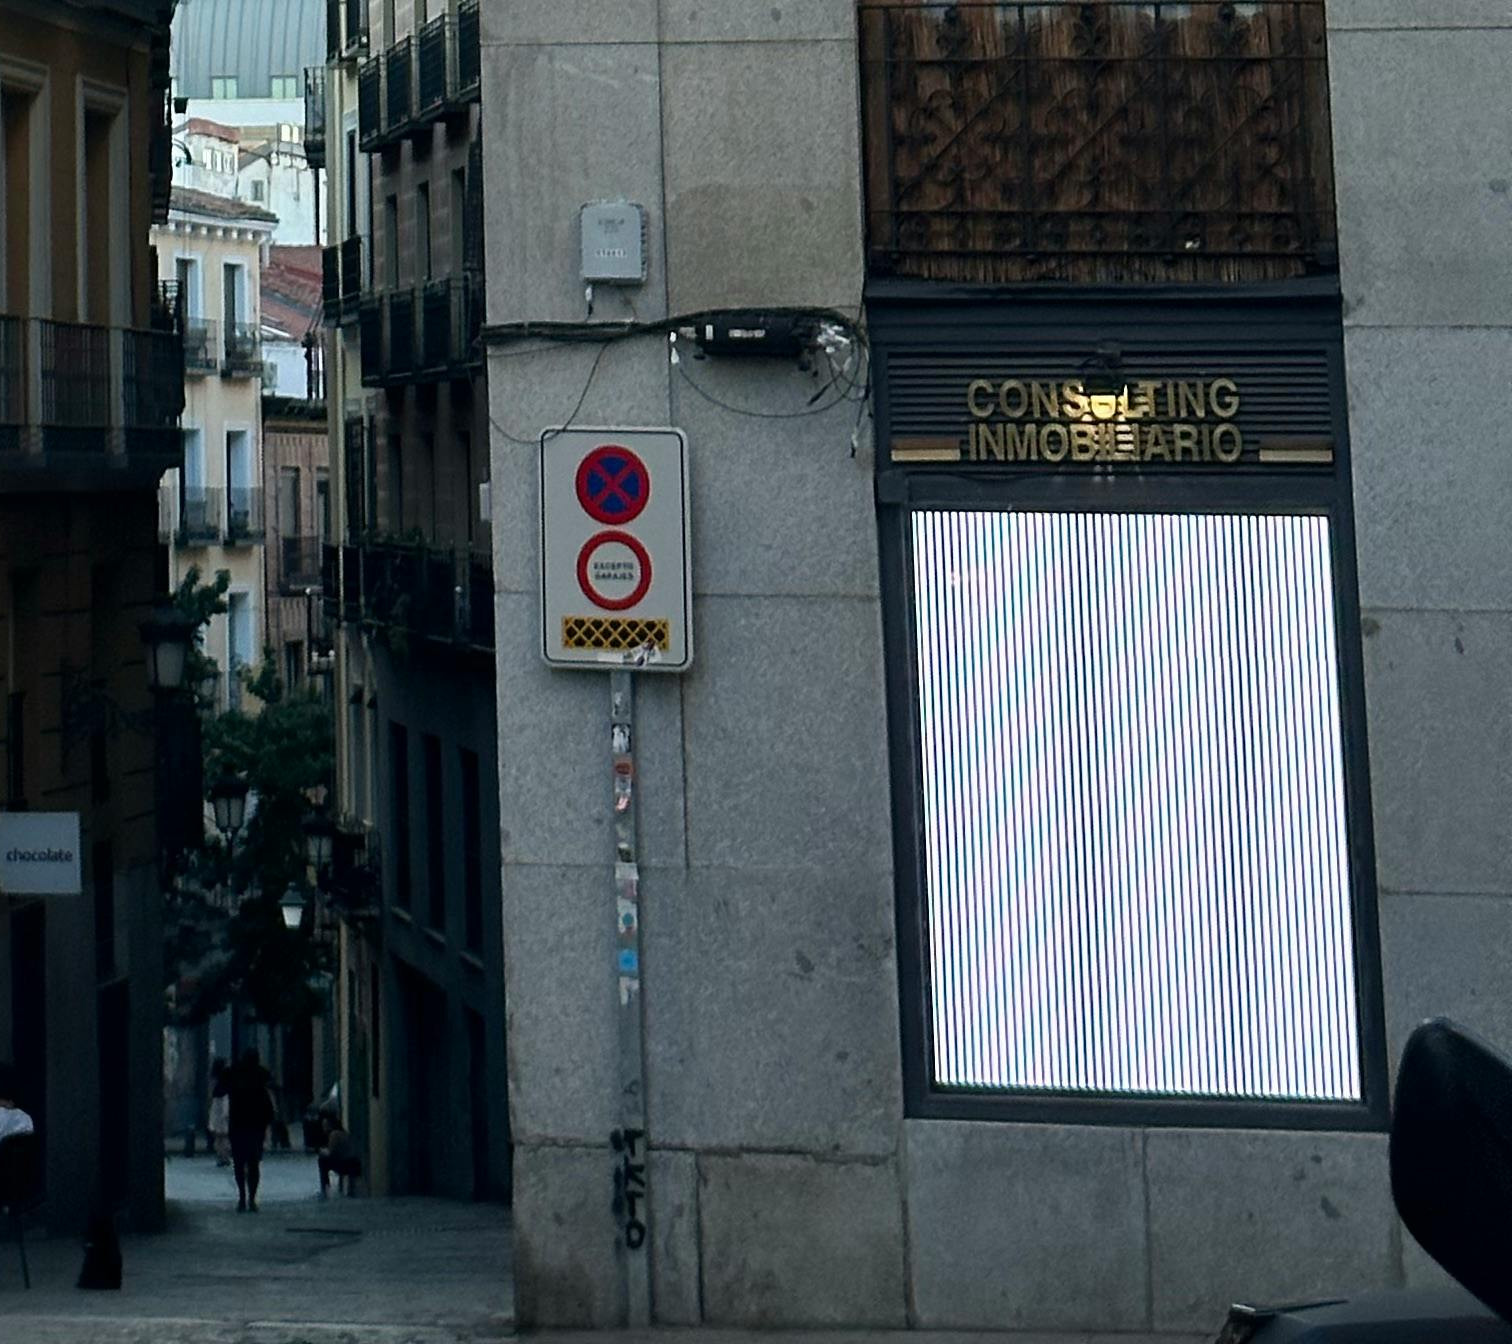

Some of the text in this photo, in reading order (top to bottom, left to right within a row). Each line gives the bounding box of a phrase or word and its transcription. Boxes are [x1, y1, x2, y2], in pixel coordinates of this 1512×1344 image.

[967, 378, 1240, 419] CONSLTING
[968, 422, 1243, 463] INMOBILIARIO
[6, 848, 73, 862] chocolate
